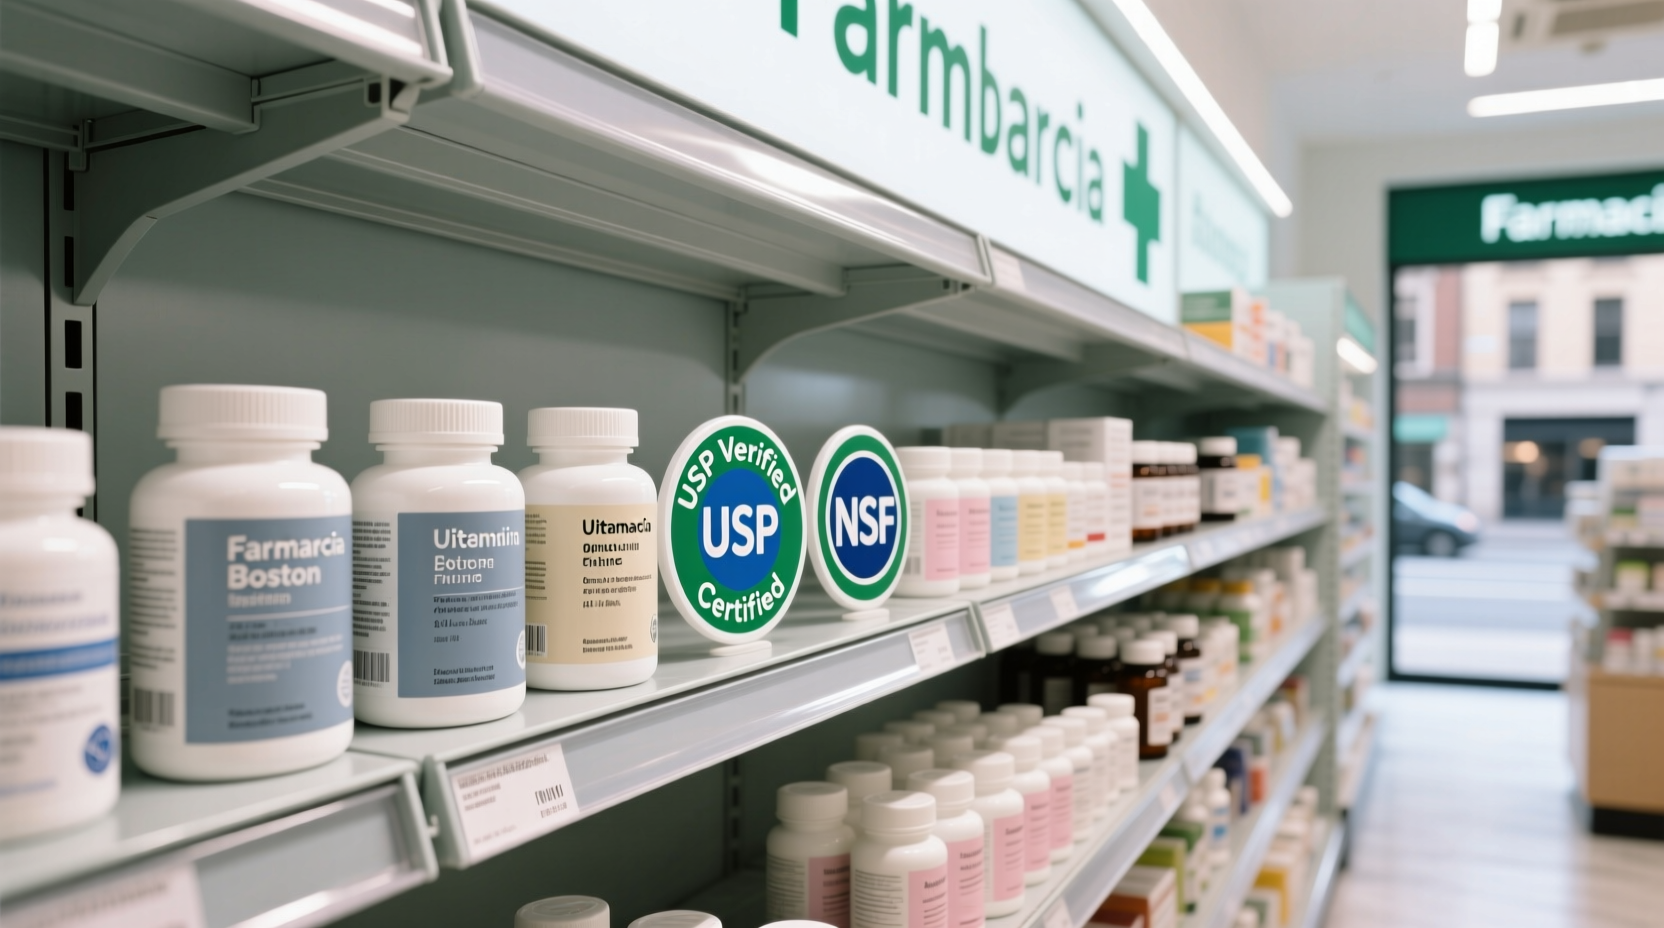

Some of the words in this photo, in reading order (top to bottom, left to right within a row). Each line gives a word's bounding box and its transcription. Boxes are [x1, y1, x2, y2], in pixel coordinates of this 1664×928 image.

[781, 0, 1104, 223] armbarcia
[677, 450, 715, 510] USP
[717, 436, 797, 506] Verified
[702, 504, 779, 558] USP
[835, 496, 895, 547] NSF
[227, 563, 322, 590] Boston
[697, 572, 785, 623] Certified
